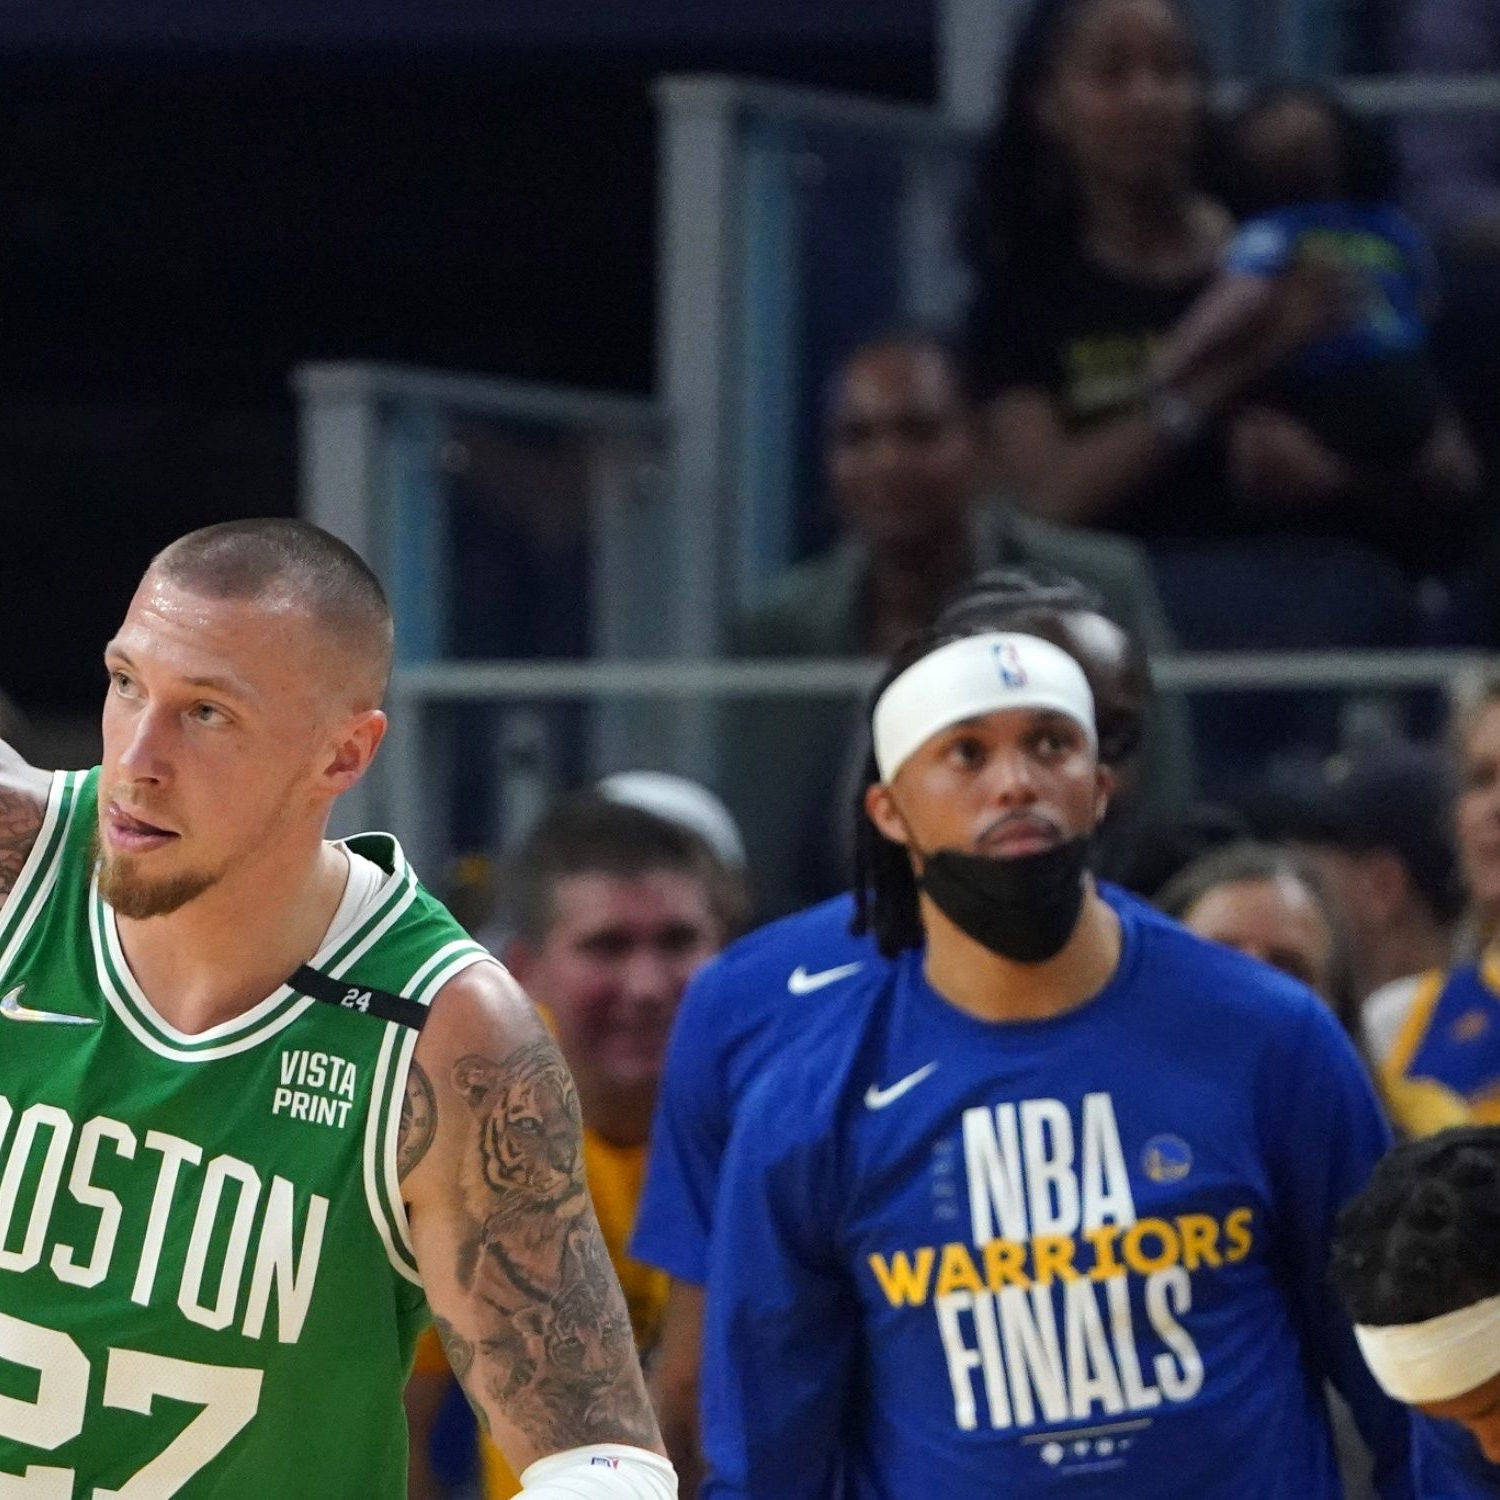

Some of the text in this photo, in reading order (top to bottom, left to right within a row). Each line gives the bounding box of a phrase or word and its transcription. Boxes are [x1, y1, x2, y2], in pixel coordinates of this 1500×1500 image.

[340, 988, 373, 1013] 24
[272, 1087, 352, 1128] PRINT
[280, 1050, 357, 1101] VISTA
[962, 1091, 1136, 1249] NBA
[868, 1207, 1253, 1308] WARRIORS
[934, 1265, 1204, 1431] FINALS
